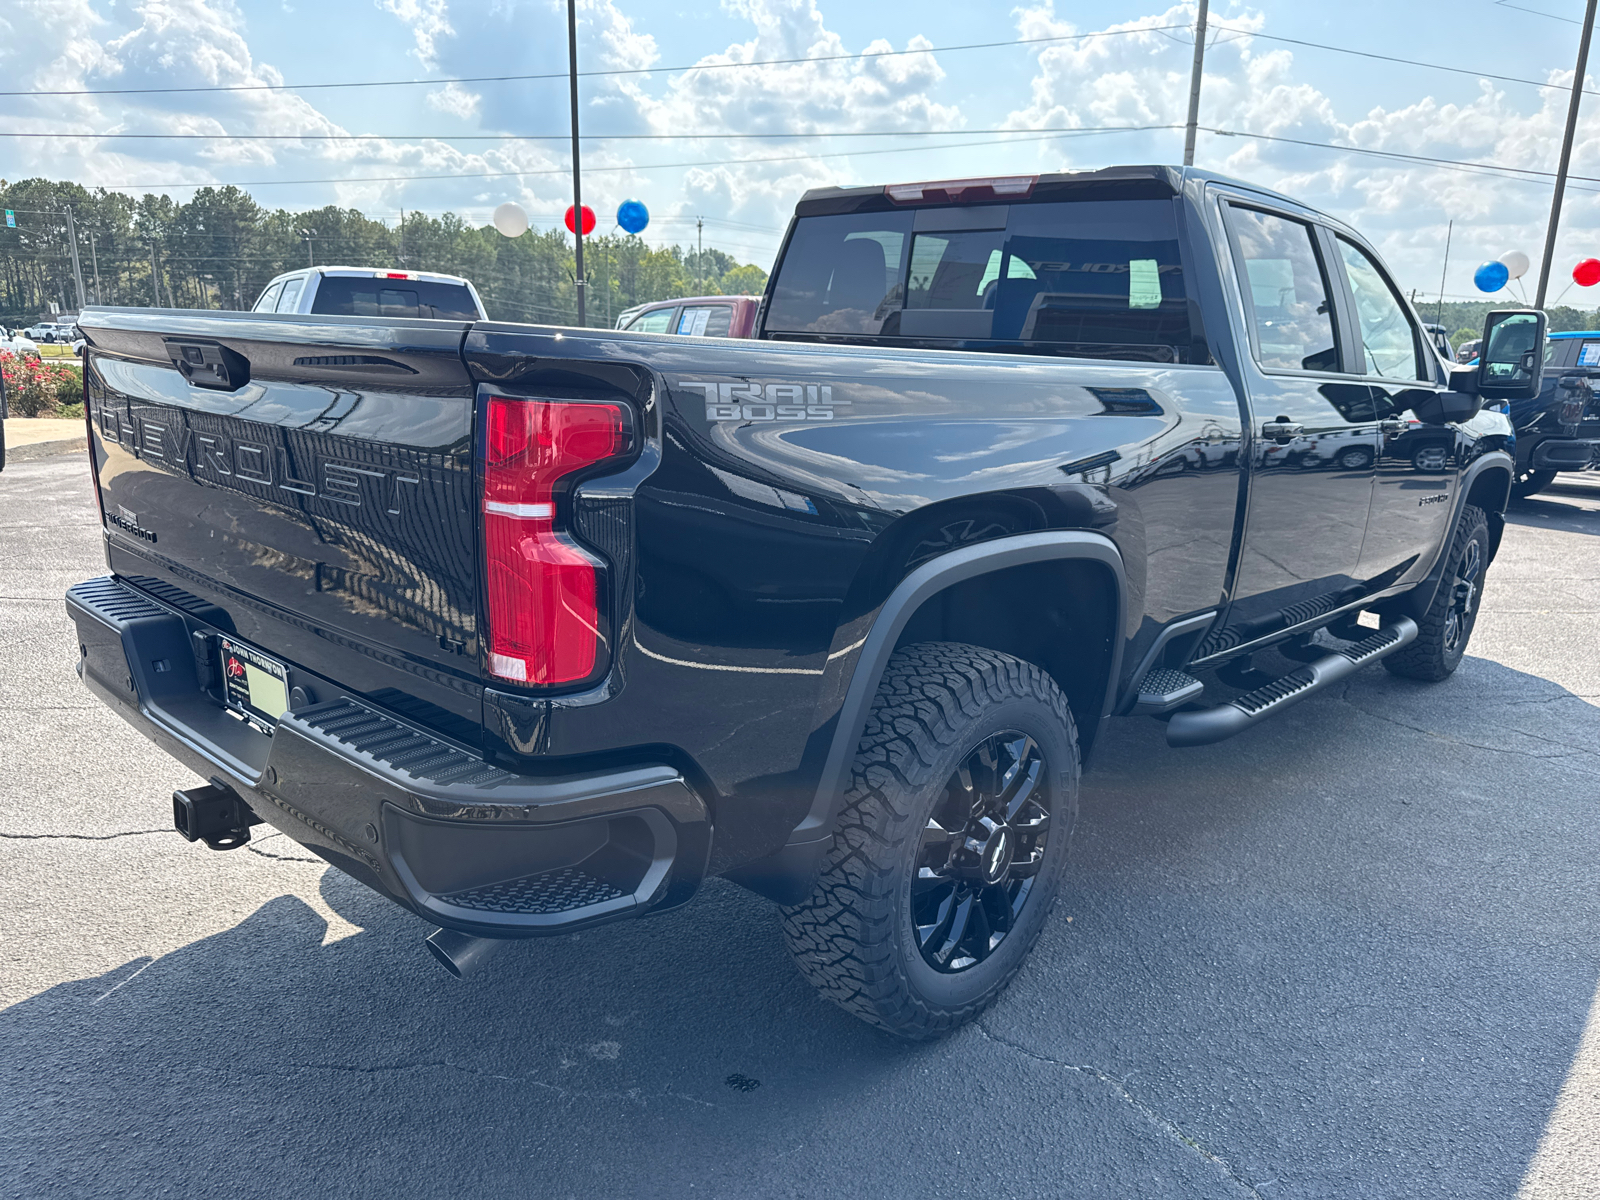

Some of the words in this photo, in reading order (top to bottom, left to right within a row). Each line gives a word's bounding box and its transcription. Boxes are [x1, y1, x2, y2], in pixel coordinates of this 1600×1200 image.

[678, 381, 852, 405] TRAIL
[706, 404, 834, 421] BOSS
[99, 405, 419, 515] CHEVROLET
[436, 634, 467, 656] LT
[233, 643, 249, 660] JOHN
[249, 652, 282, 677] THORNTON
